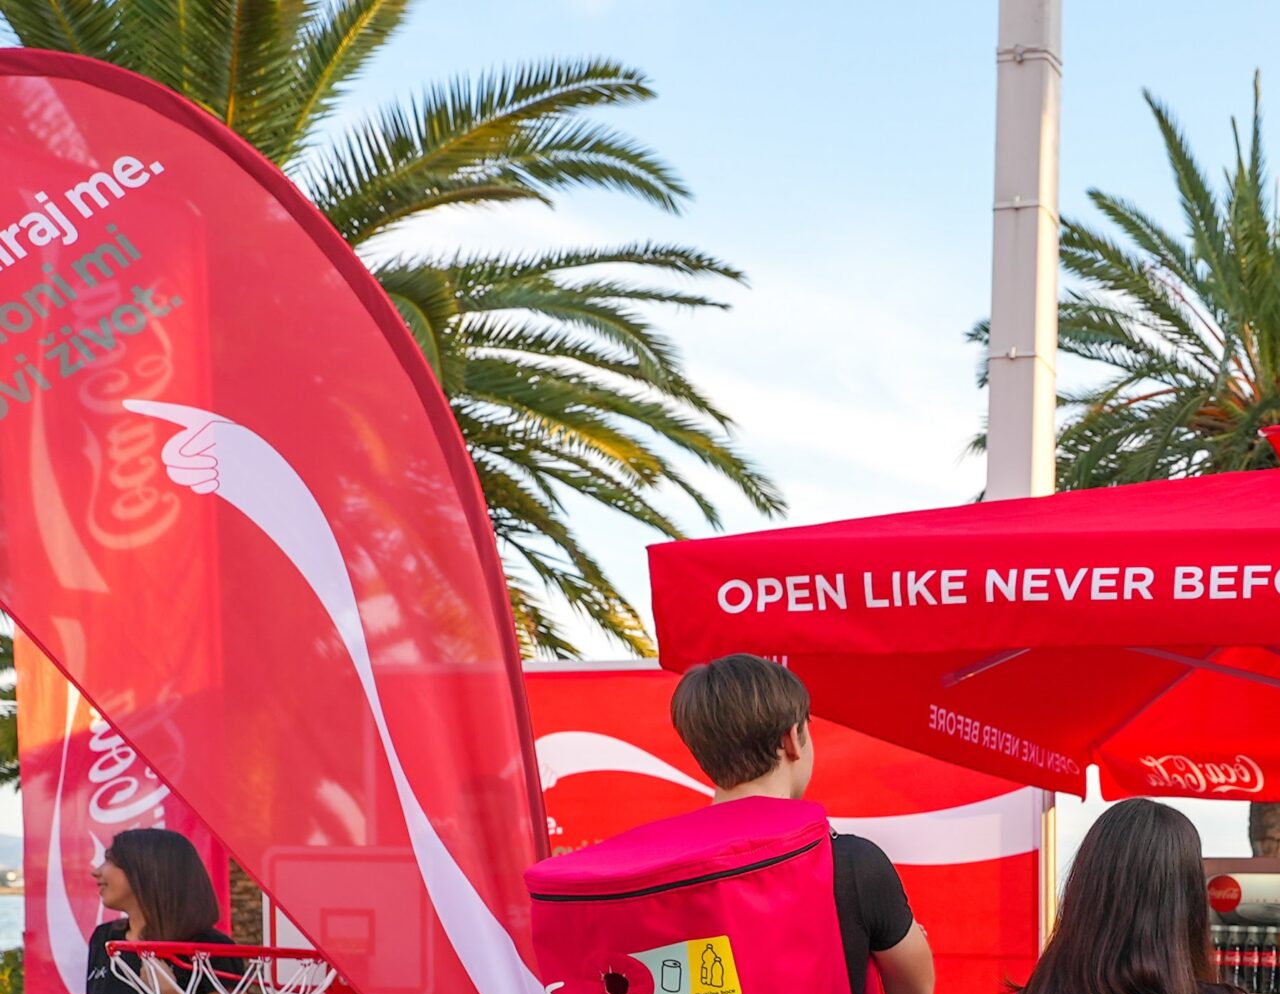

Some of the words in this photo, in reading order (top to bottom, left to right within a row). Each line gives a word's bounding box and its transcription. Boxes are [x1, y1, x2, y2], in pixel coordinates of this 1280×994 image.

[65, 155, 165, 219] me.
[0, 262, 78, 344] oni
[71, 223, 142, 288] mi
[38, 284, 183, 378] život.
[717, 573, 847, 614] OPEN
[863, 570, 967, 608] LIKE
[985, 567, 1155, 602] NEVER
